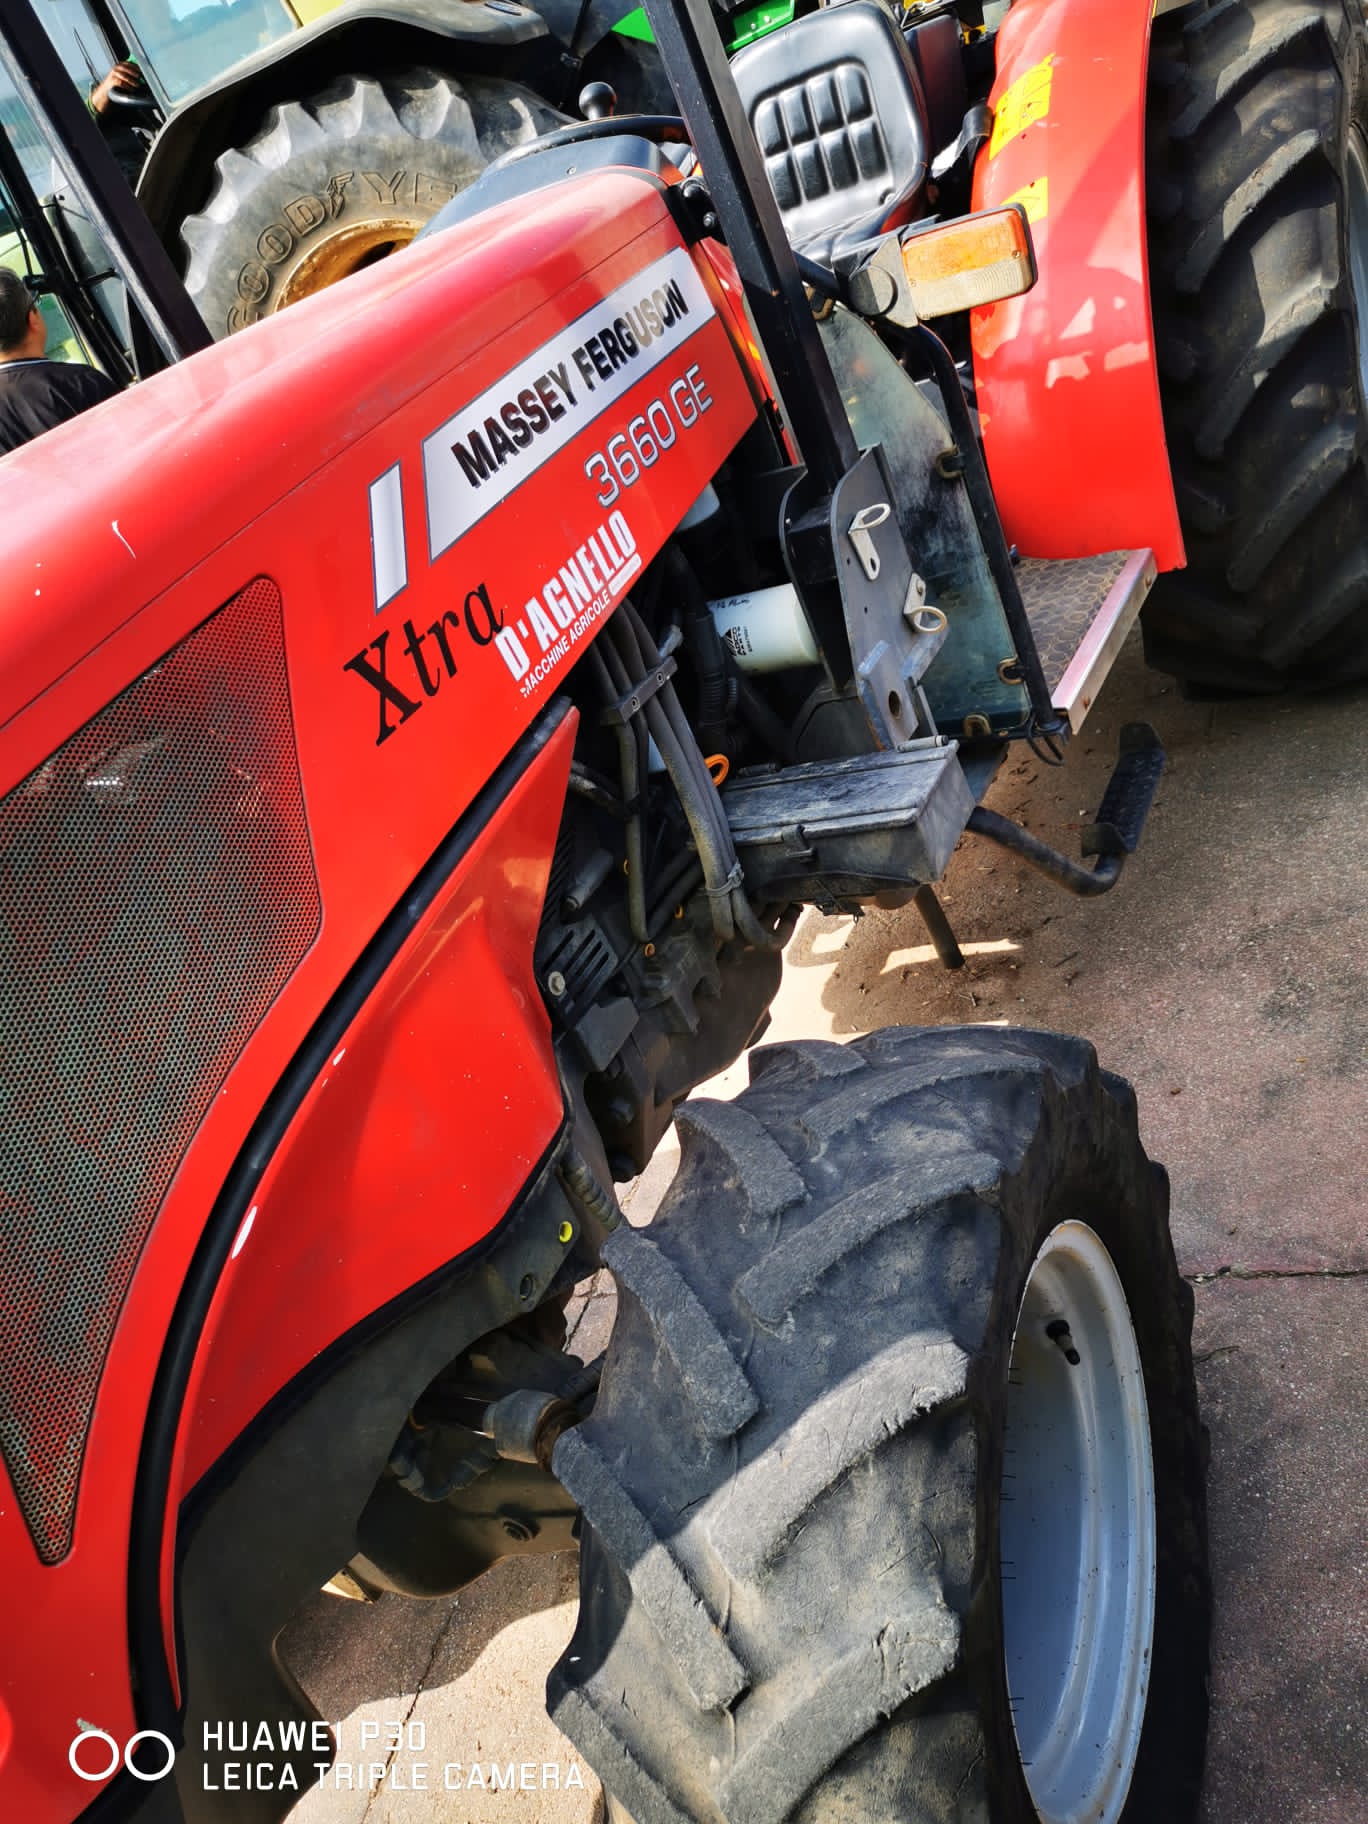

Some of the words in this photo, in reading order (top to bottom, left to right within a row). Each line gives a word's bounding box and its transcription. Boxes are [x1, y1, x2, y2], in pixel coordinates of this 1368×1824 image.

[451, 370, 578, 488] MASSEY
[571, 278, 690, 392] FERGUSON
[584, 404, 676, 508] 3660
[668, 364, 715, 430] GE
[343, 582, 506, 747] Xtra
[494, 509, 638, 683] D'AGNELLO
[521, 639, 571, 697] MACCHINE
[570, 589, 611, 645] AGRICOLE
